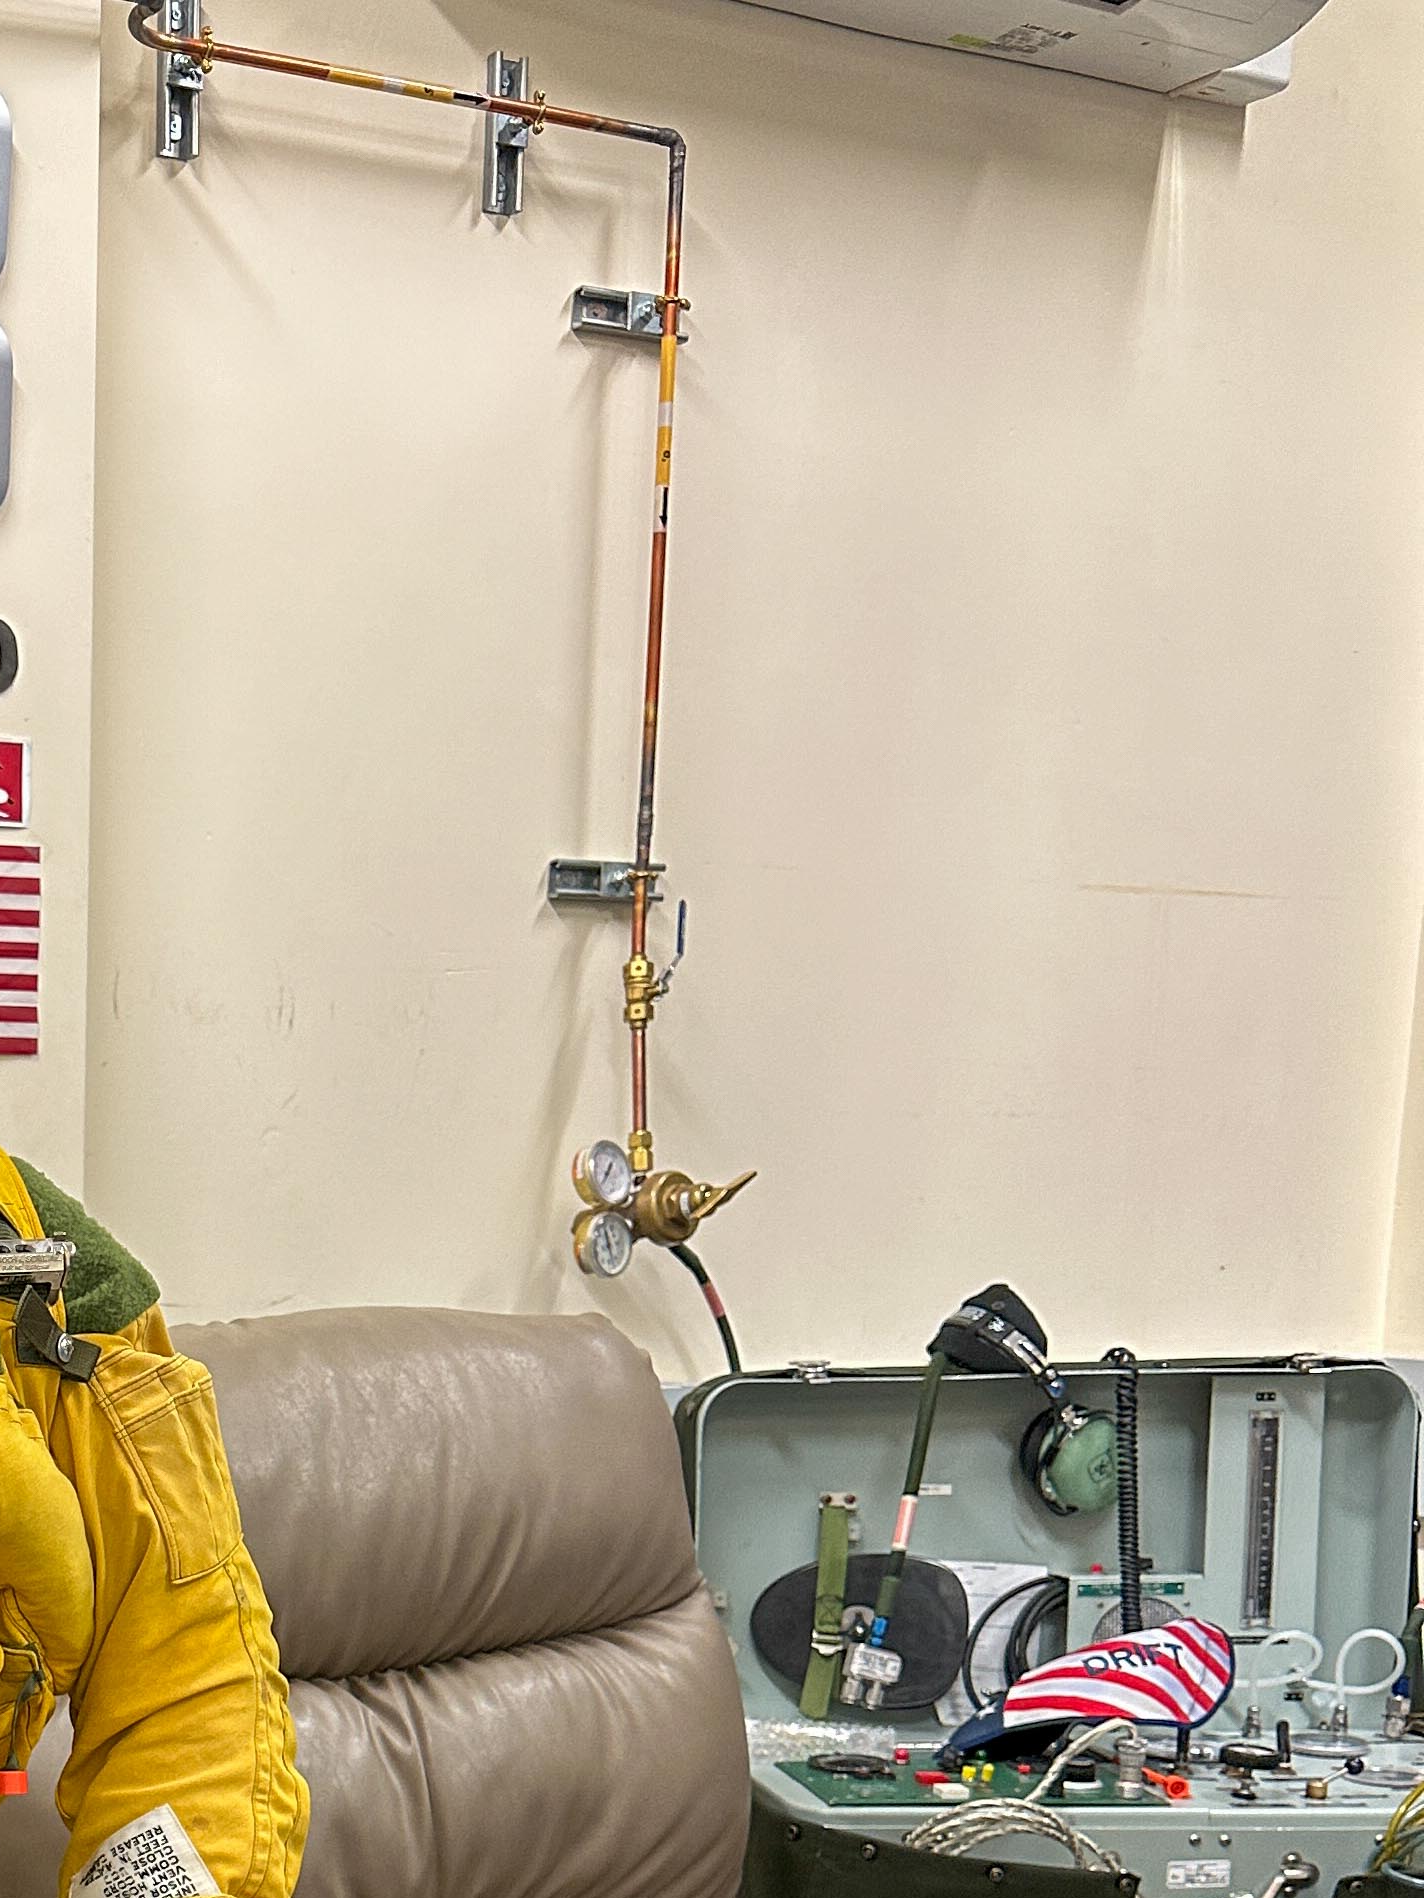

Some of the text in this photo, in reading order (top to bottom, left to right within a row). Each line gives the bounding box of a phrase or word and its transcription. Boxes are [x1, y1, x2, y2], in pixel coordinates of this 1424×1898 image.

[1081, 1642, 1183, 1676] DRIFT
[110, 1825, 164, 1857] RELEASE
[136, 1835, 169, 1857] FEET
[131, 1845, 174, 1871] CLOSE
[103, 1876, 135, 1898] CORD
[150, 1875, 192, 1898] VISOR
[152, 1865, 187, 1887] VENT
